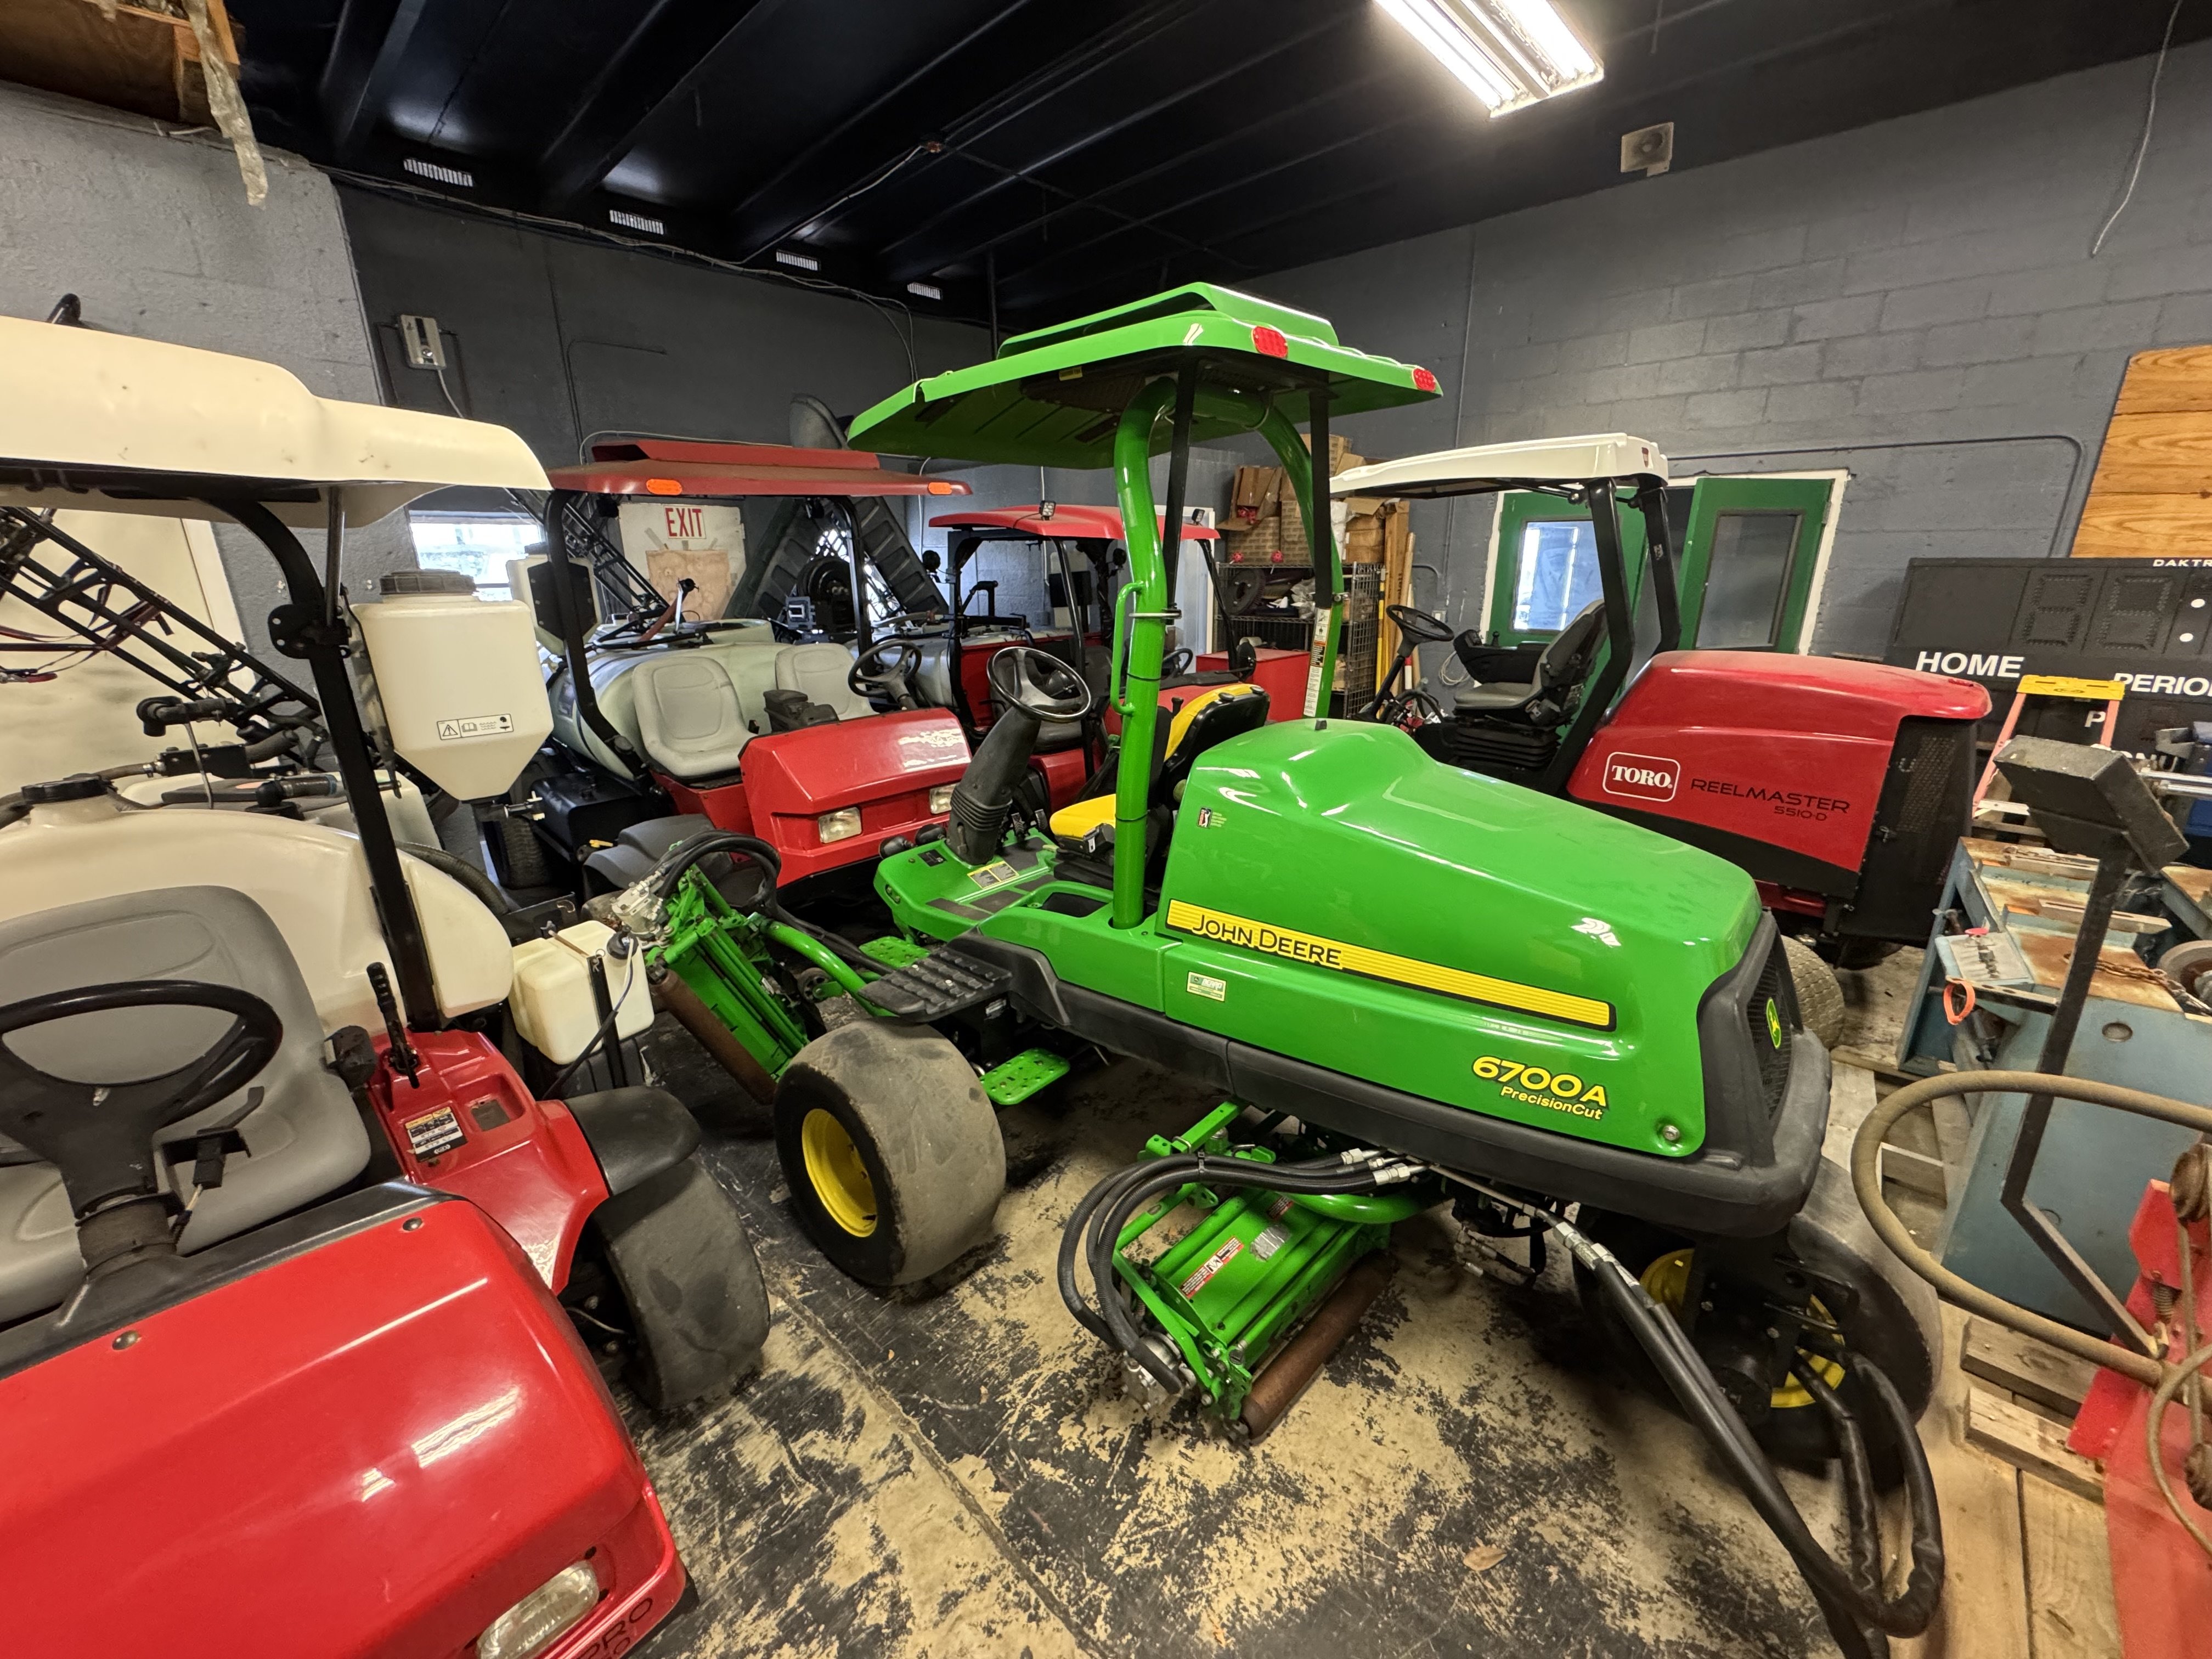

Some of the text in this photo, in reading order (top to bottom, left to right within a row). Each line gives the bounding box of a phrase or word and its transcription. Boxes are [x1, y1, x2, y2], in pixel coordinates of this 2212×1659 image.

[665, 508, 702, 537] EXIT
[1915, 651, 2024, 678] HOME
[2114, 673, 2212, 697] PERIO
[1691, 778, 1850, 813] REELMASTER
[1193, 915, 1342, 966] JOHN DEERE
[1473, 1056, 1607, 1107] 6700A
[1500, 1086, 1603, 1120] PrecisionCut
